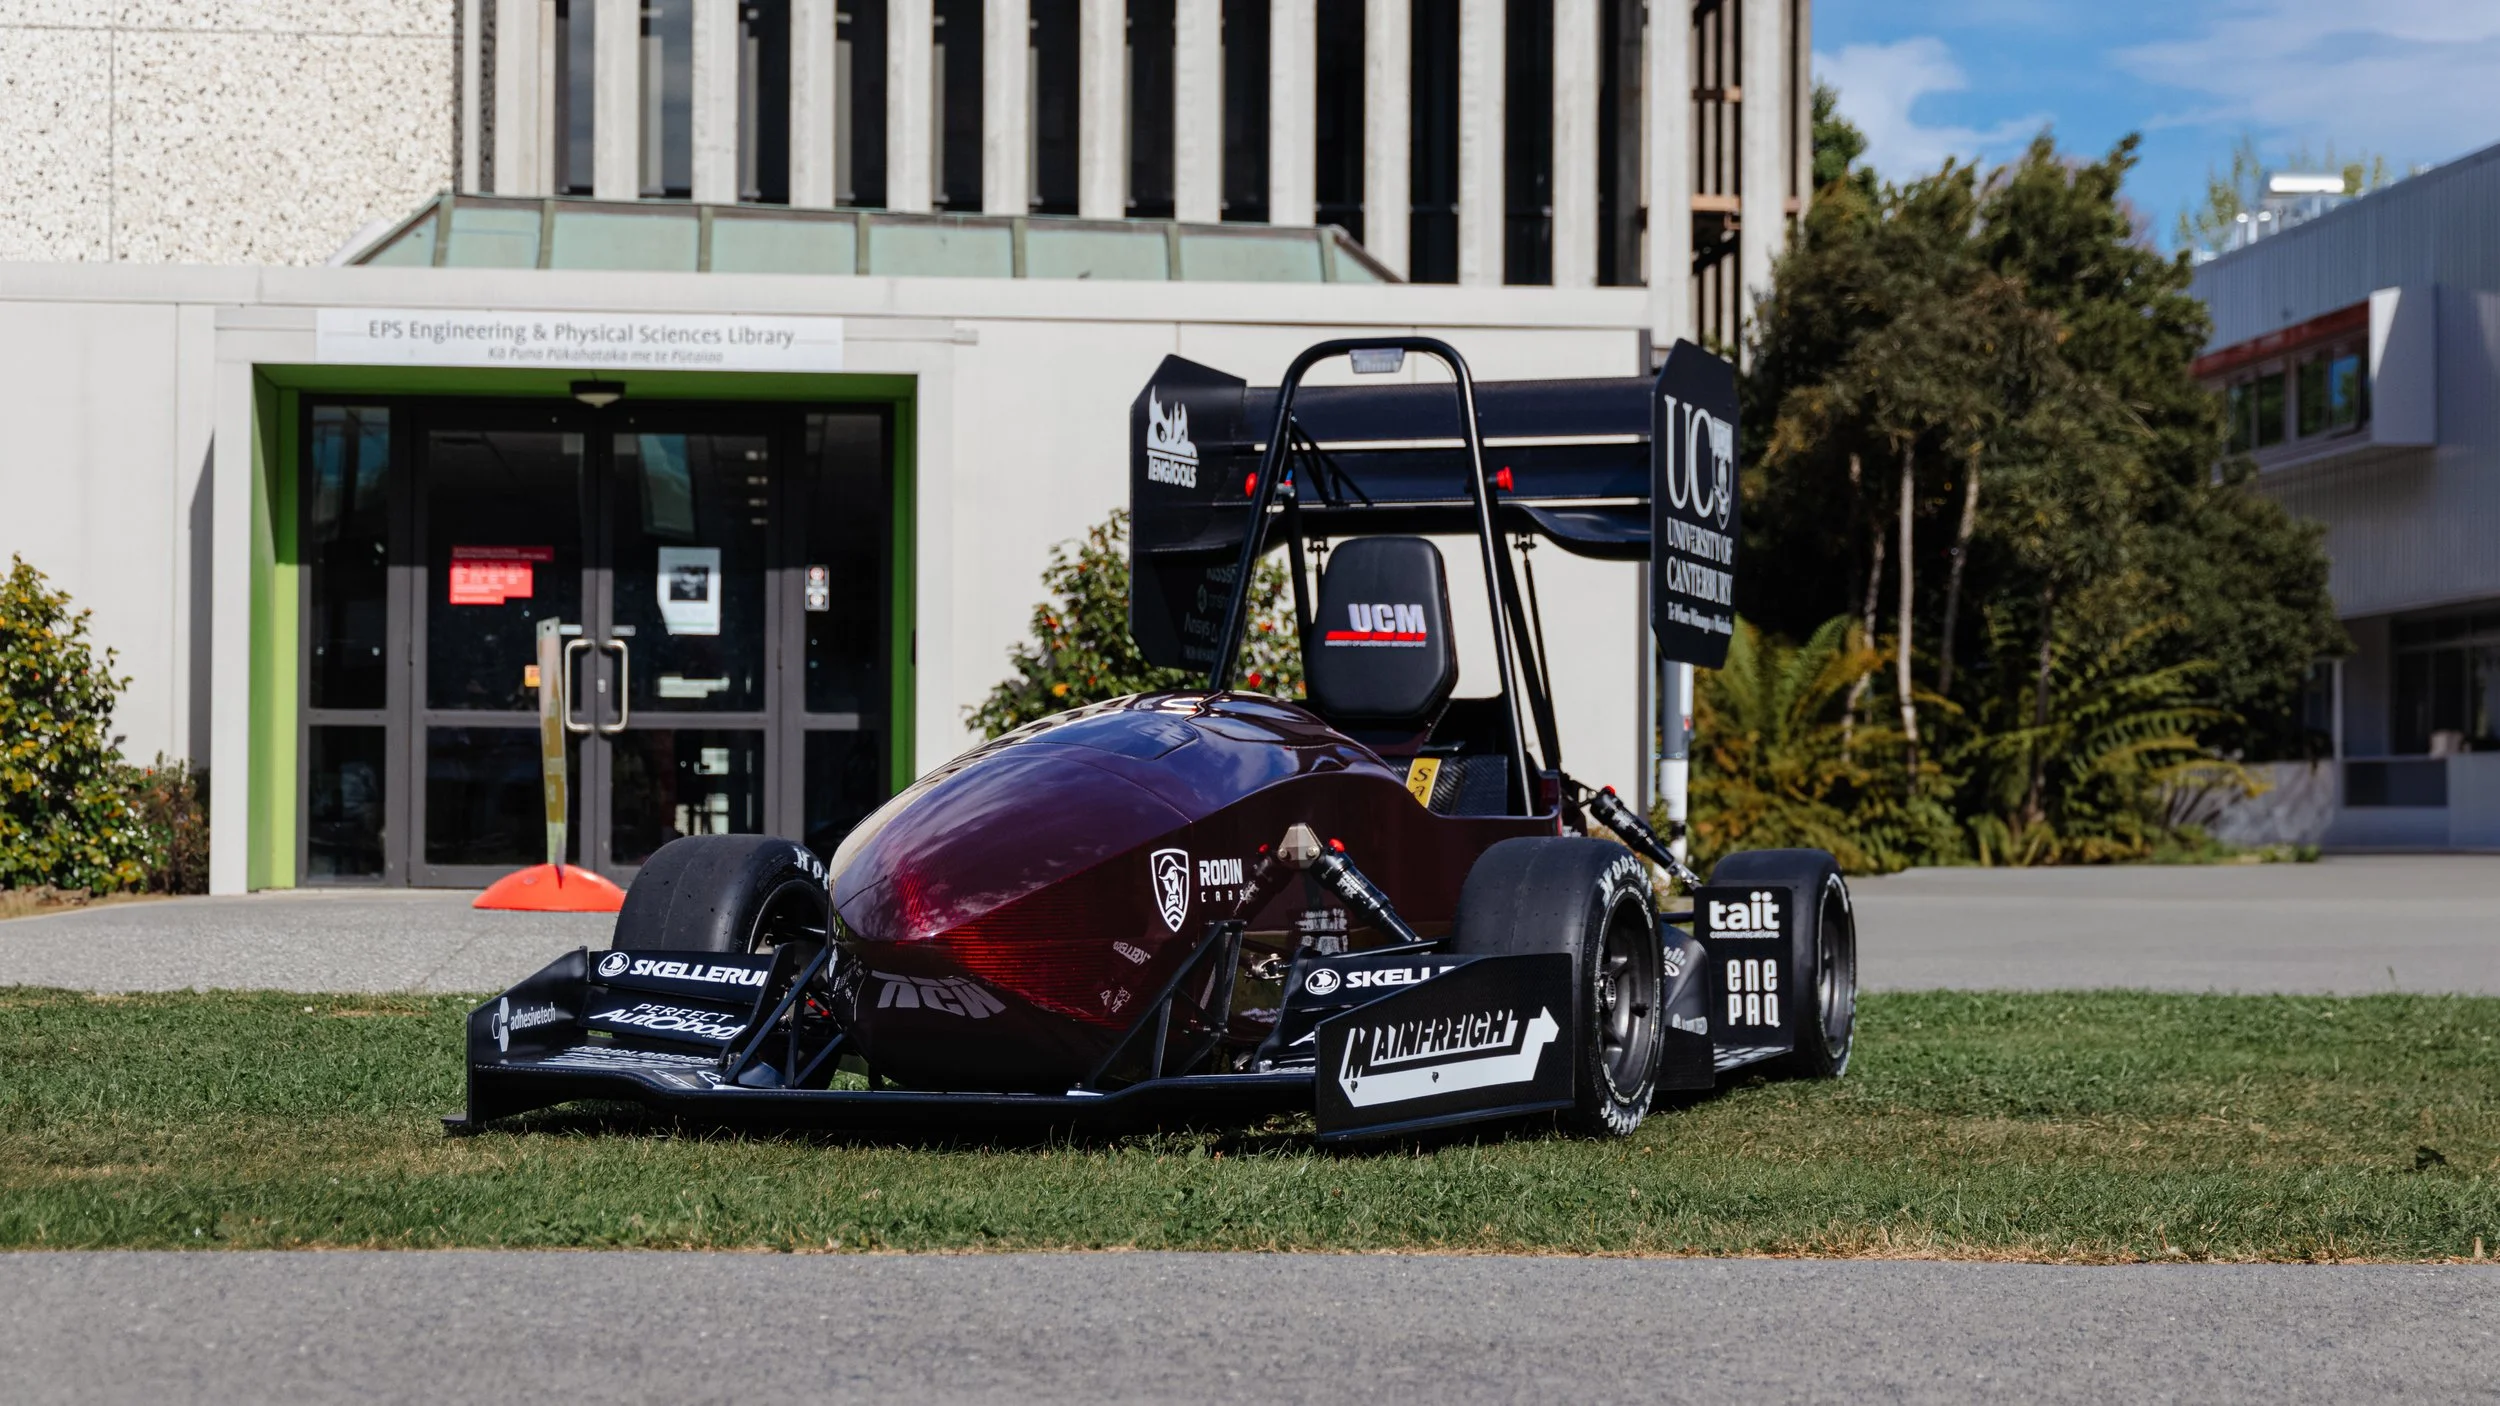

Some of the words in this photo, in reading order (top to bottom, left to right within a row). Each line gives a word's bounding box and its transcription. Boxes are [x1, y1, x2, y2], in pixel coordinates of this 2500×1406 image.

[368, 320, 403, 340] EPS
[409, 321, 526, 345] Engineering
[532, 323, 547, 341] &
[554, 323, 634, 347] Physical
[639, 325, 722, 344] Sciences
[728, 328, 796, 349] Library
[1664, 394, 1714, 518] UC
[1667, 516, 1721, 562] UNIVERSITY
[1720, 535, 1733, 565] OF
[1667, 555, 1733, 606] CANTERBURY
[1348, 603, 1427, 634] UCM
[1199, 858, 1244, 887] RODIN
[1709, 891, 1780, 931] tait
[1727, 958, 1777, 993] ene
[510, 1001, 556, 1031] adhesivetech
[632, 1003, 735, 1023] PERFECT
[1728, 993, 1780, 1028] PAQ
[1343, 1008, 1528, 1081] MAINFREIGHT
